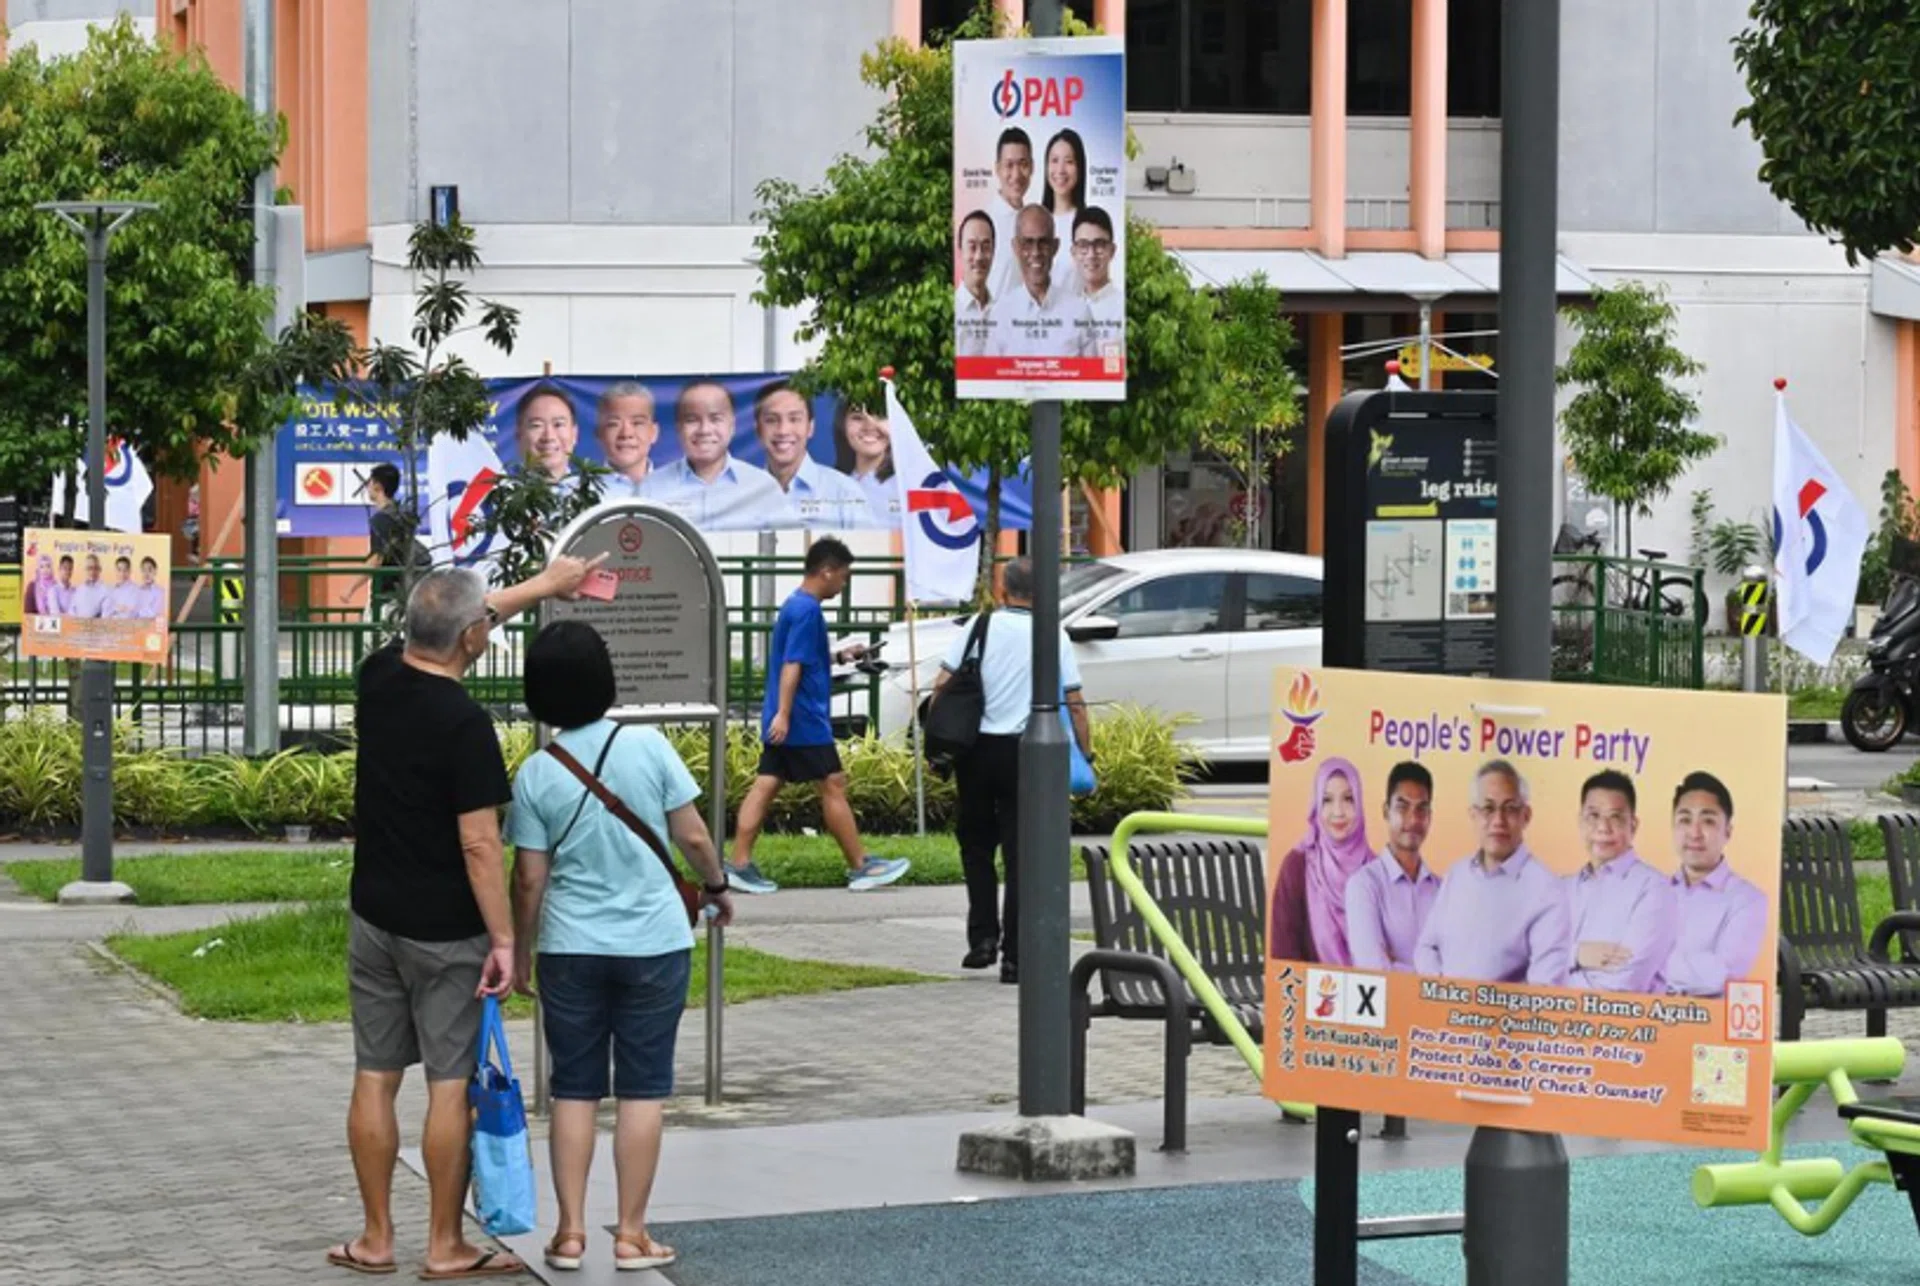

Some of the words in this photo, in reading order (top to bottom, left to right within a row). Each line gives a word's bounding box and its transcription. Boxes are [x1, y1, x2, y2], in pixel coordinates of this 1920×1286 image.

[1023, 77, 1085, 117] PAP
[1420, 478, 1450, 502] leg
[1369, 709, 1472, 759] People's
[1480, 717, 1565, 758] Power
[1574, 723, 1650, 774] Party
[1356, 983, 1378, 1017] X
[1420, 980, 1471, 1003] Make
[1476, 985, 1578, 1013] Singapore
[1582, 994, 1645, 1019] Home
[1649, 1000, 1711, 1026] Again
[1448, 1010, 1497, 1029] Better
[1500, 1015, 1560, 1037] Quality
[1562, 1019, 1596, 1039] Life
[1599, 1021, 1628, 1041] For
[1629, 1025, 1657, 1043] All
[1409, 1046, 1463, 1065] Protect
[1466, 1051, 1503, 1070] Jobs
[1506, 1056, 1524, 1072] &
[1527, 1058, 1593, 1078] Careers
[1410, 1028, 1493, 1051] Pro-Family
[1496, 1035, 1587, 1060] Population
[1591, 1043, 1645, 1066] Policy
[1468, 1071, 1535, 1093] Ownself
[1537, 1077, 1590, 1096] Check
[1593, 1083, 1665, 1105] Ownself
